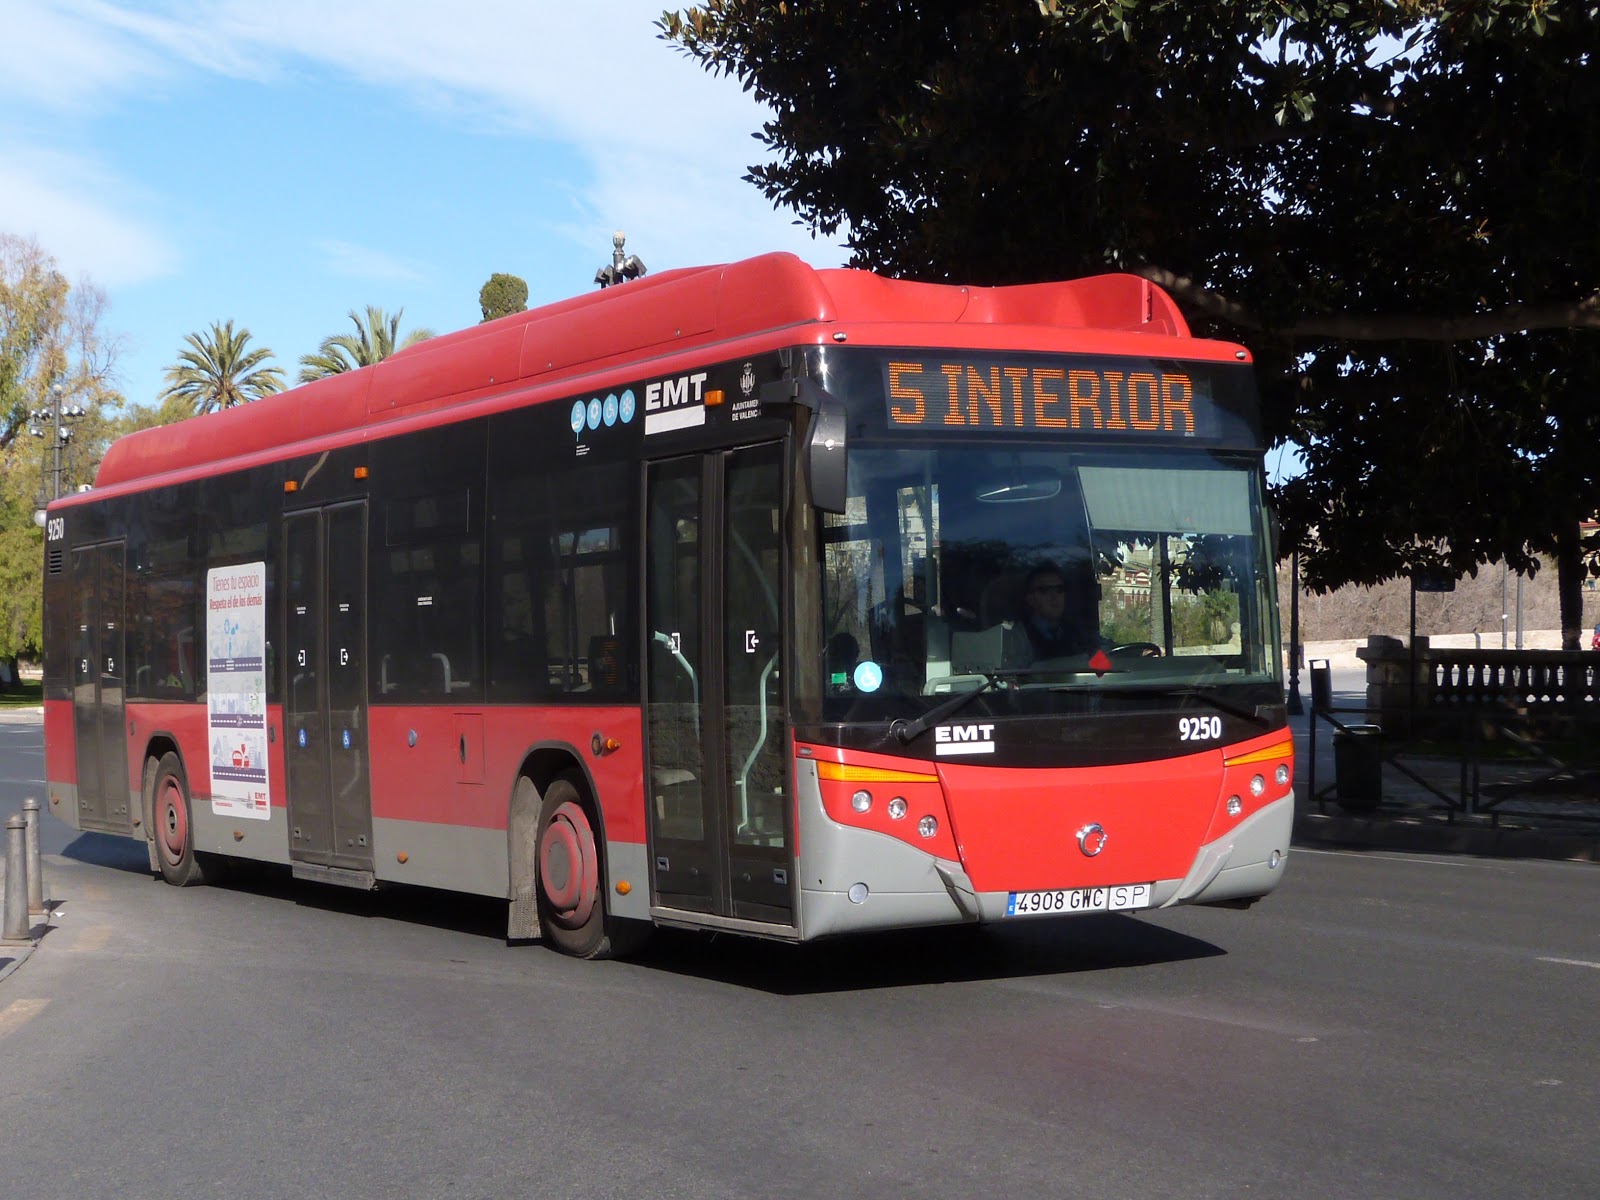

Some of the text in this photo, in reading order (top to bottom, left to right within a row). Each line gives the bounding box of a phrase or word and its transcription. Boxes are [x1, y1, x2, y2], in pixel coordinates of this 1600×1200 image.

[646, 372, 707, 411] EMT
[889, 362, 1195, 431] 5 INTERIOR
[48, 517, 64, 541] 9250
[213, 571, 260, 592] Tienes tu espacio
[209, 597, 226, 612] Respeta
[935, 724, 995, 742] EMT
[1179, 716, 1221, 741] 9250
[255, 792, 266, 800] EMT
[1018, 891, 1064, 912] 4908
[1070, 889, 1103, 909] GWC
